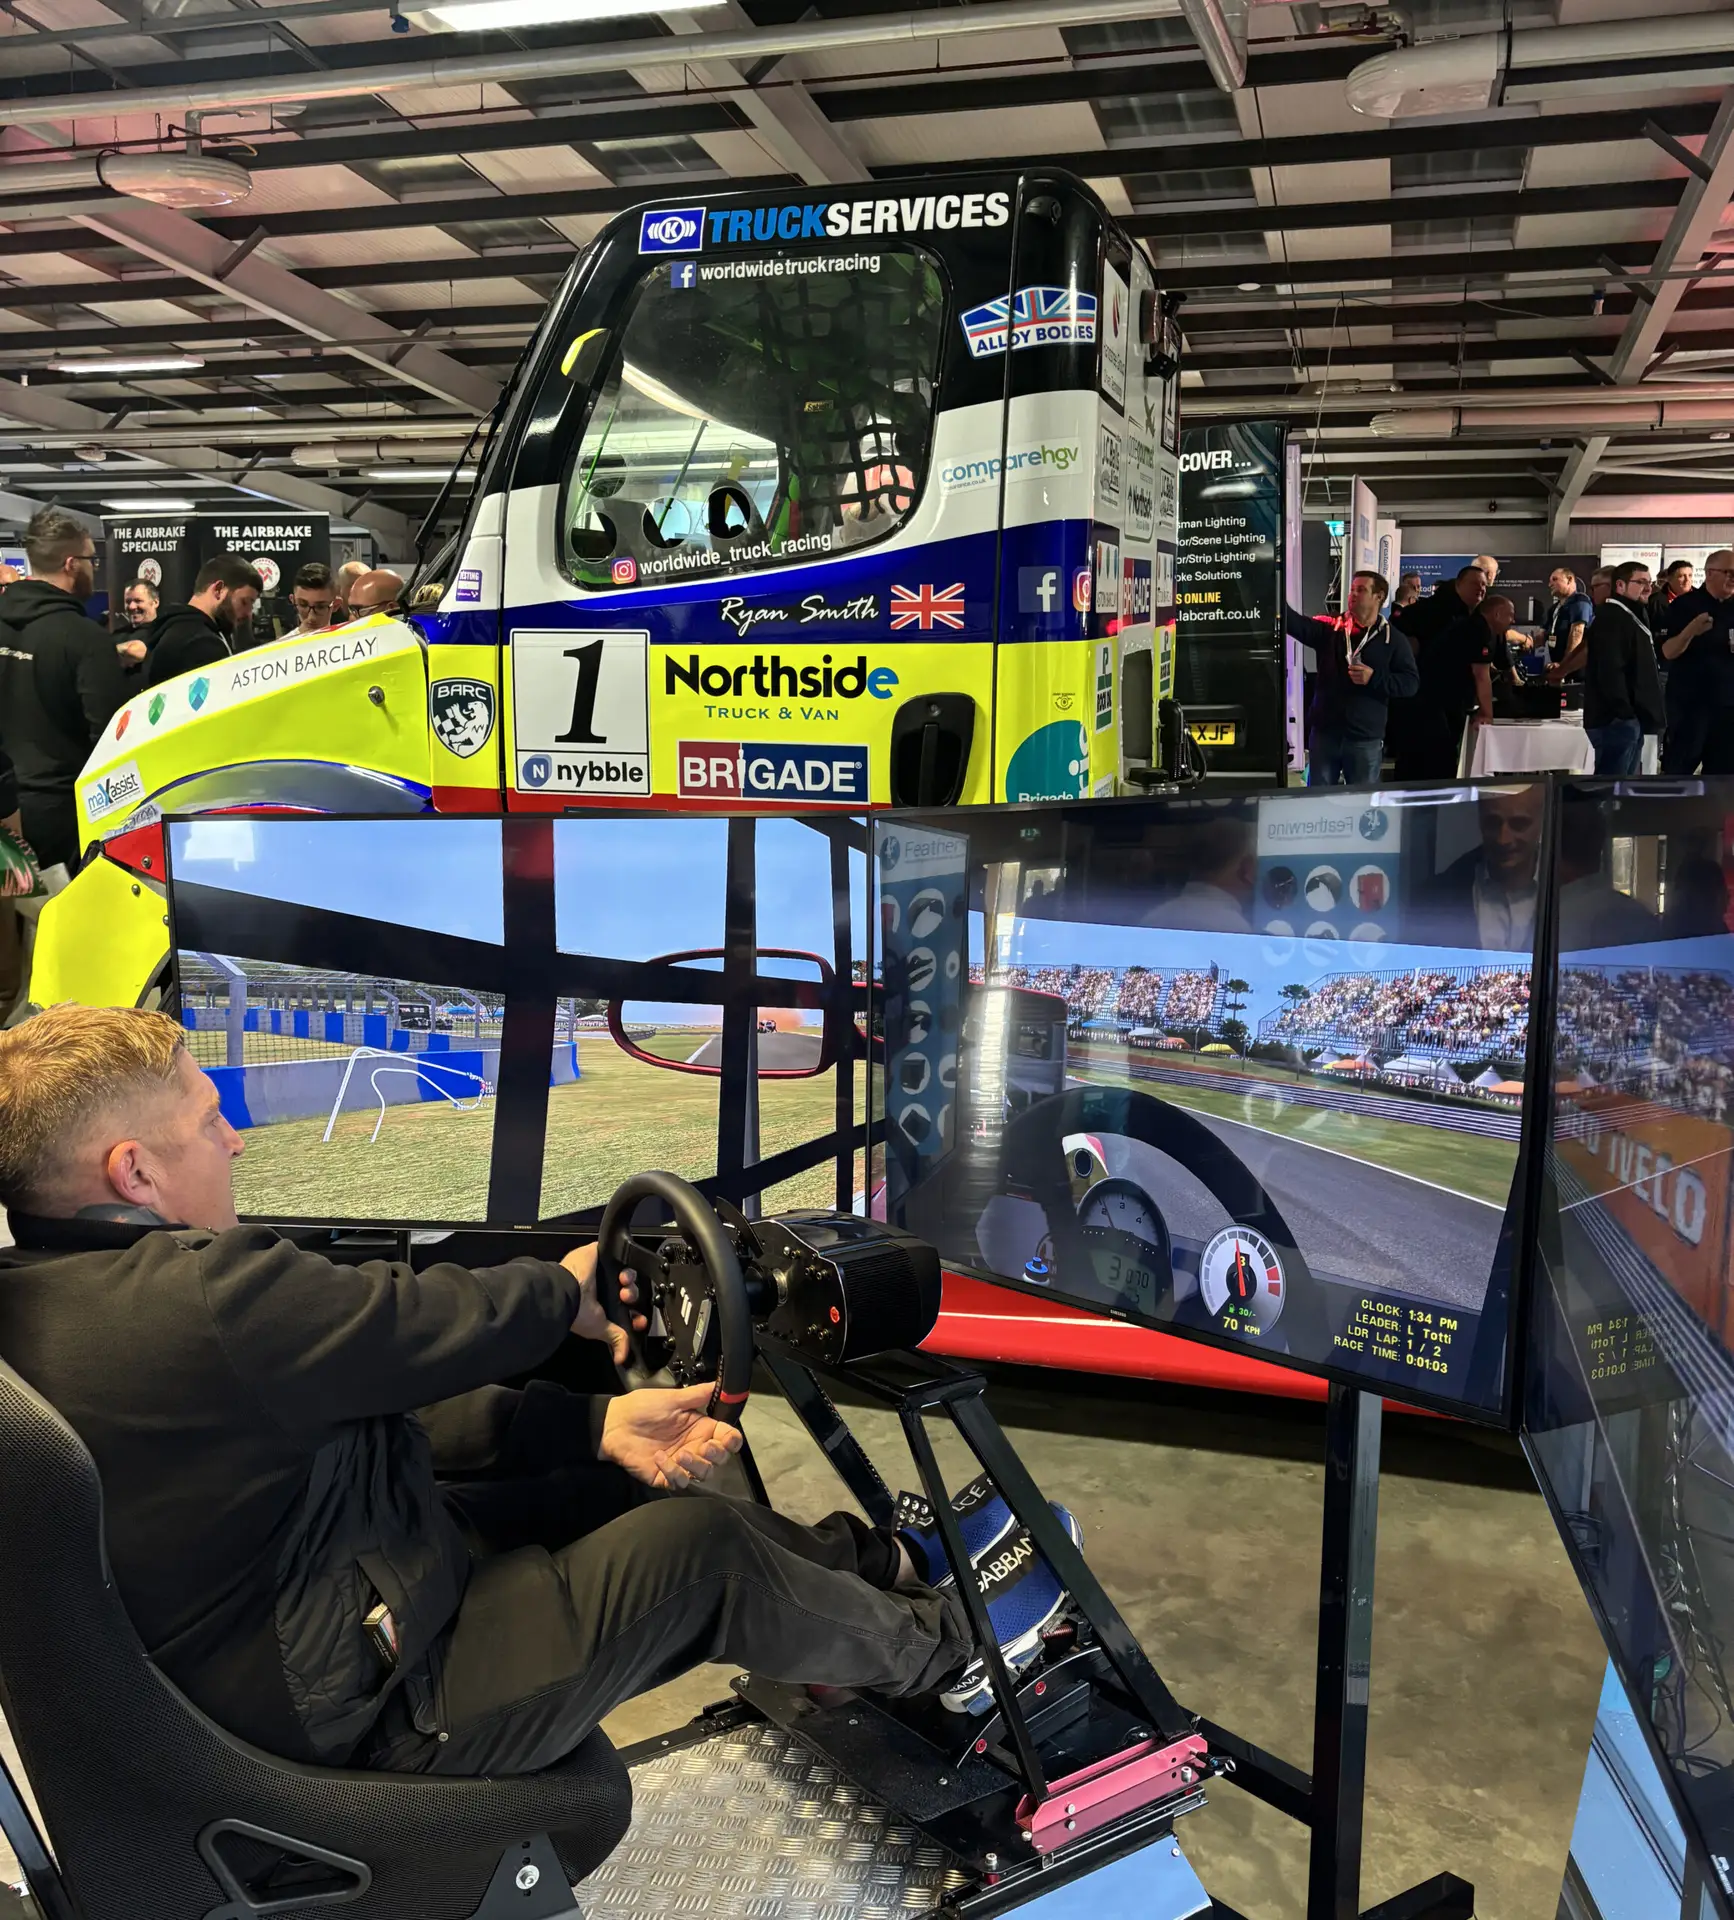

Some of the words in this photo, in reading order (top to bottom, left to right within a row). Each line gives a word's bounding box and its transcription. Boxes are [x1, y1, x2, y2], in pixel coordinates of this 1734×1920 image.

[976, 329, 1031, 354] ALLOY
[1036, 325, 1093, 341] BODIES
[942, 444, 1079, 483] comparehgv
[113, 527, 132, 540] THE
[134, 526, 186, 539] AIRBRAKE
[213, 526, 240, 538] THE
[242, 525, 313, 538] AIRBRAKE
[1204, 516, 1247, 530] Lighting
[121, 540, 178, 553] SPECIALIST
[226, 540, 302, 552] SPECIALIST
[1224, 533, 1266, 545] Lighting
[639, 532, 832, 575] worldwide_truck_racing
[1214, 551, 1256, 563] Lighting
[1194, 570, 1243, 581] Solutions
[1175, 593, 1183, 605] S
[1184, 592, 1222, 604] ONLINE
[720, 596, 790, 637] Ryan
[799, 594, 880, 623] Smith
[231, 659, 288, 691] ASTON
[294, 636, 377, 673] BARCLAY
[664, 653, 900, 699] Northside
[437, 684, 488, 701] BARC
[554, 639, 608, 745] 1
[778, 706, 792, 720] &
[557, 760, 644, 787] nybble
[683, 749, 857, 793] BRIGADE
[1222, 1316, 1239, 1331] 70
[1244, 1324, 1261, 1336] KPH
[1355, 1312, 1402, 1332] LEADER:
[1407, 1325, 1414, 1336] L
[1422, 1328, 1452, 1344] Totti
[1361, 1299, 1403, 1318] CLOCK:
[1408, 1309, 1432, 1325] 1:34
[1439, 1317, 1458, 1331] PM
[1347, 1324, 1369, 1339] LDR
[1376, 1332, 1401, 1347] LAP:
[1407, 1339, 1413, 1350] 1
[1433, 1346, 1442, 1357] 2
[1333, 1335, 1364, 1352] RACE
[1371, 1345, 1401, 1361] TIME:
[1406, 1353, 1448, 1374] 0:01:03
